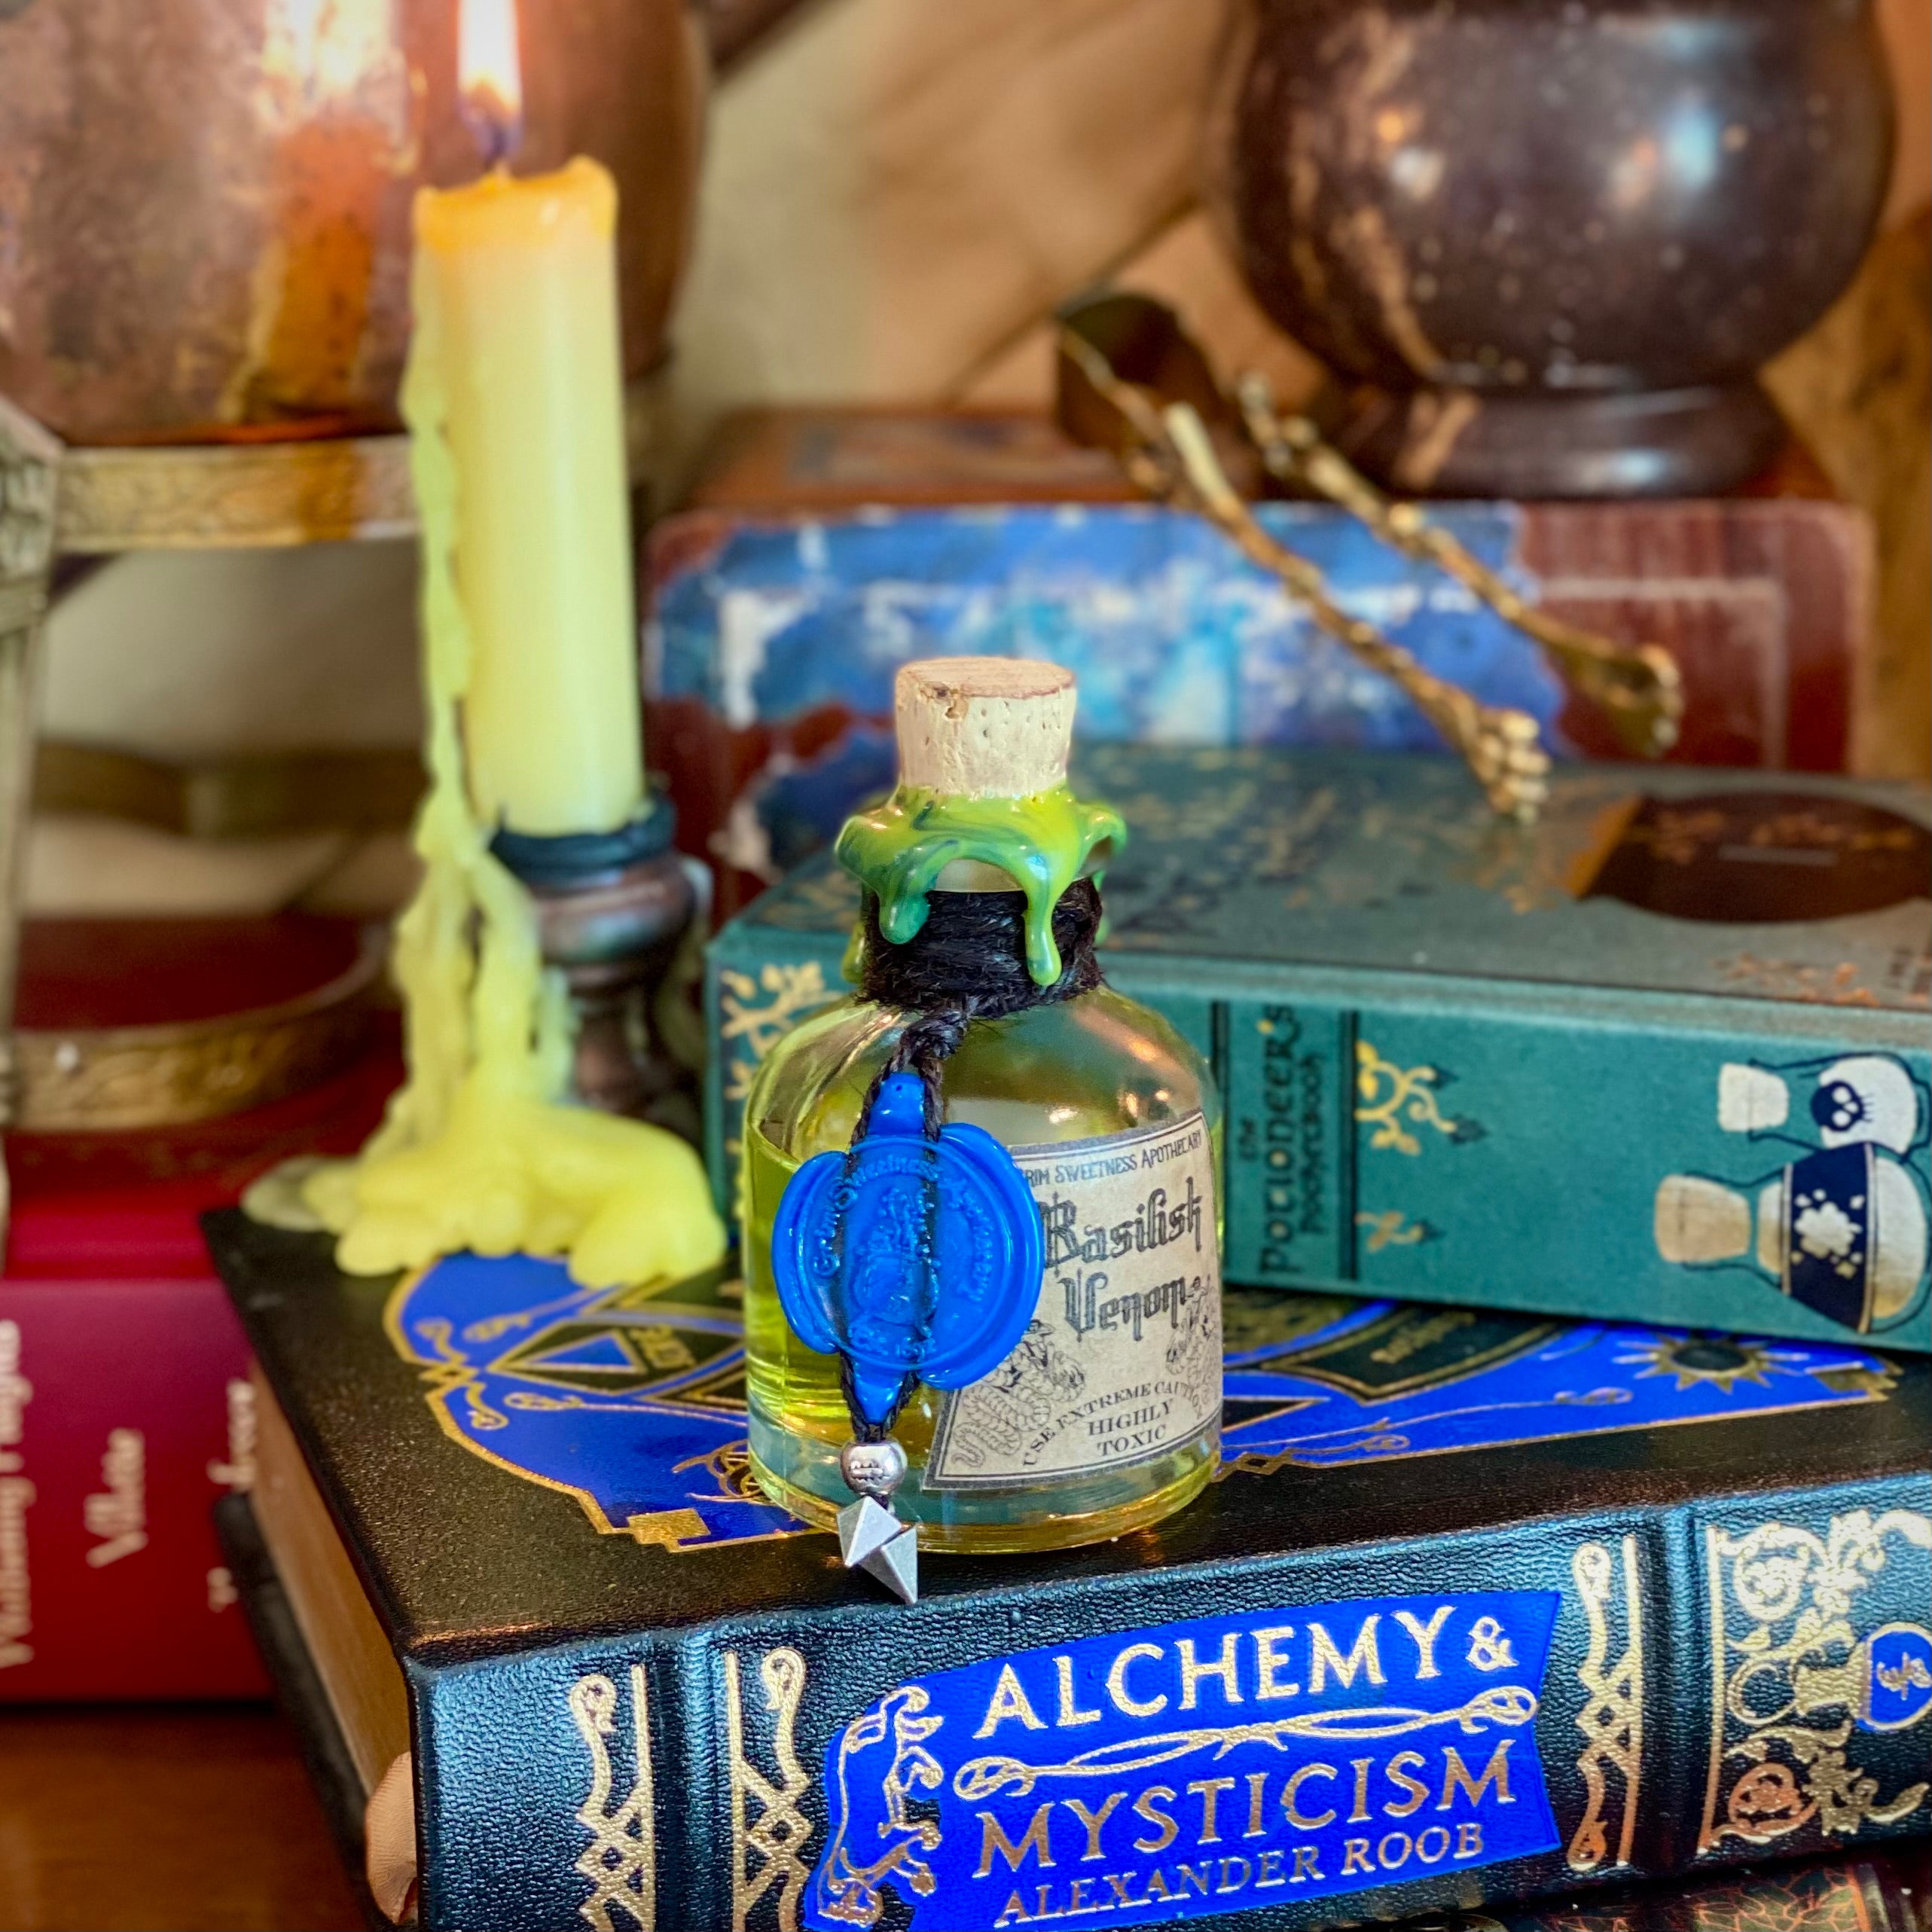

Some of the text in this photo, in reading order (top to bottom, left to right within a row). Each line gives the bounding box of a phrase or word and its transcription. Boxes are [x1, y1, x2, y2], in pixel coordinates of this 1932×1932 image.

[1023, 1169, 1050, 1188] RIM
[1037, 1176, 1203, 1278] Basilisk
[1057, 1268, 1187, 1343] Venom
[1023, 1427, 1056, 1467] USE
[1055, 1382, 1152, 1430] EXTREME
[1088, 1398, 1174, 1437] HIGHLY
[1097, 1424, 1167, 1457] TOXIC
[972, 1605, 1518, 1740] ALCHEMY &
[972, 1739, 1517, 1879] MYSTICISM
[992, 1822, 1485, 1929] ALEXANDER ROOB
